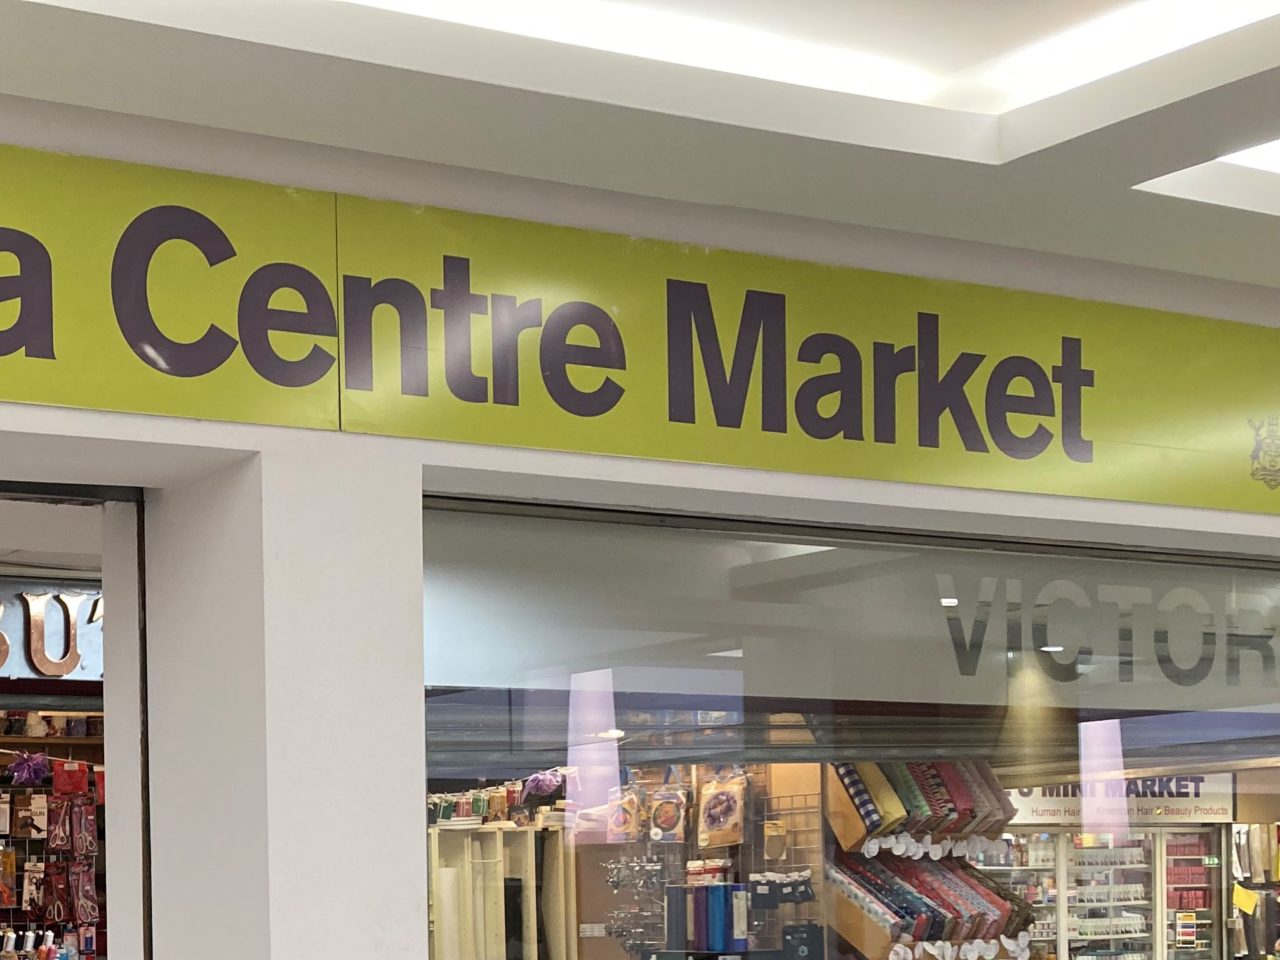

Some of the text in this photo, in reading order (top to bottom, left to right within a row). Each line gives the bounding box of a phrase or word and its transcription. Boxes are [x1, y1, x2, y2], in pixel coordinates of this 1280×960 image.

[110, 204, 627, 418] Centre
[665, 278, 1095, 464] Market
[1104, 776, 1205, 798] MARKET
[1031, 807, 1062, 817] Human
[1064, 807, 1081, 816] Hair
[1136, 806, 1153, 816] Hair
[1164, 805, 1192, 817] Beauty
[1194, 805, 1229, 816] Products
